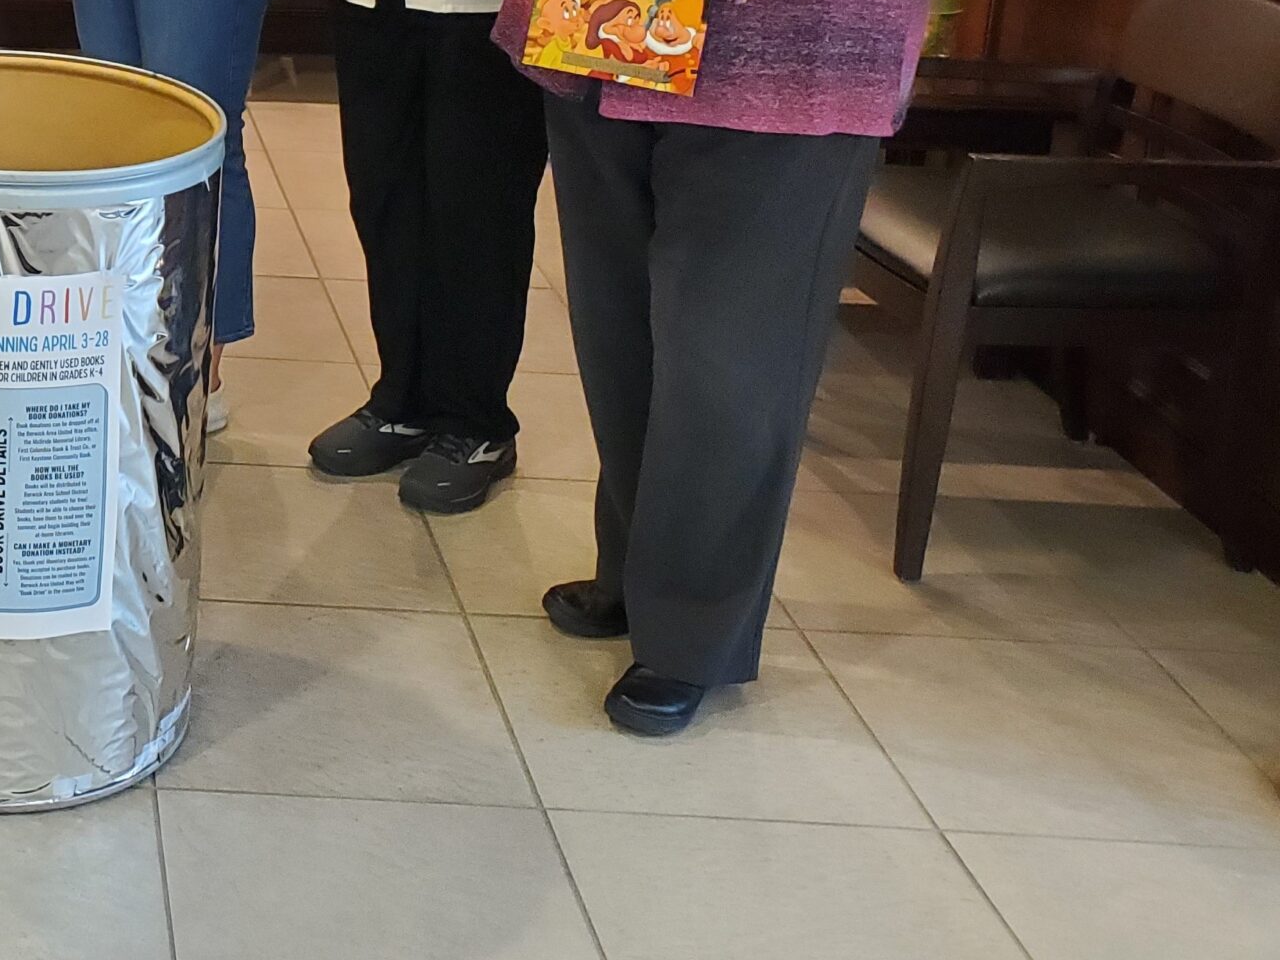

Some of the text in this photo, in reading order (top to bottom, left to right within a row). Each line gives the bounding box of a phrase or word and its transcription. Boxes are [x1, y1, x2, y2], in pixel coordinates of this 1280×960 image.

[13, 284, 116, 326] DRIVE
[42, 333, 77, 352] APRIL
[82, 331, 109, 349] 3-28
[12, 360, 28, 371] AND
[30, 359, 59, 371] GENTLY
[60, 357, 79, 369] USED
[80, 356, 104, 367] BOOKS
[11, 371, 48, 382] CHILDREN
[49, 370, 58, 381] IN
[59, 369, 88, 380] GRADES
[89, 367, 103, 377] K-4
[26, 405, 47, 413] WHERE
[29, 410, 87, 420] BOOK DONATIONS?
[64, 471, 84, 480] USED?
[33, 542, 50, 550] MAKE
[58, 539, 91, 548] MONETARY
[22, 547, 85, 557] DONATION INSTEAD?
